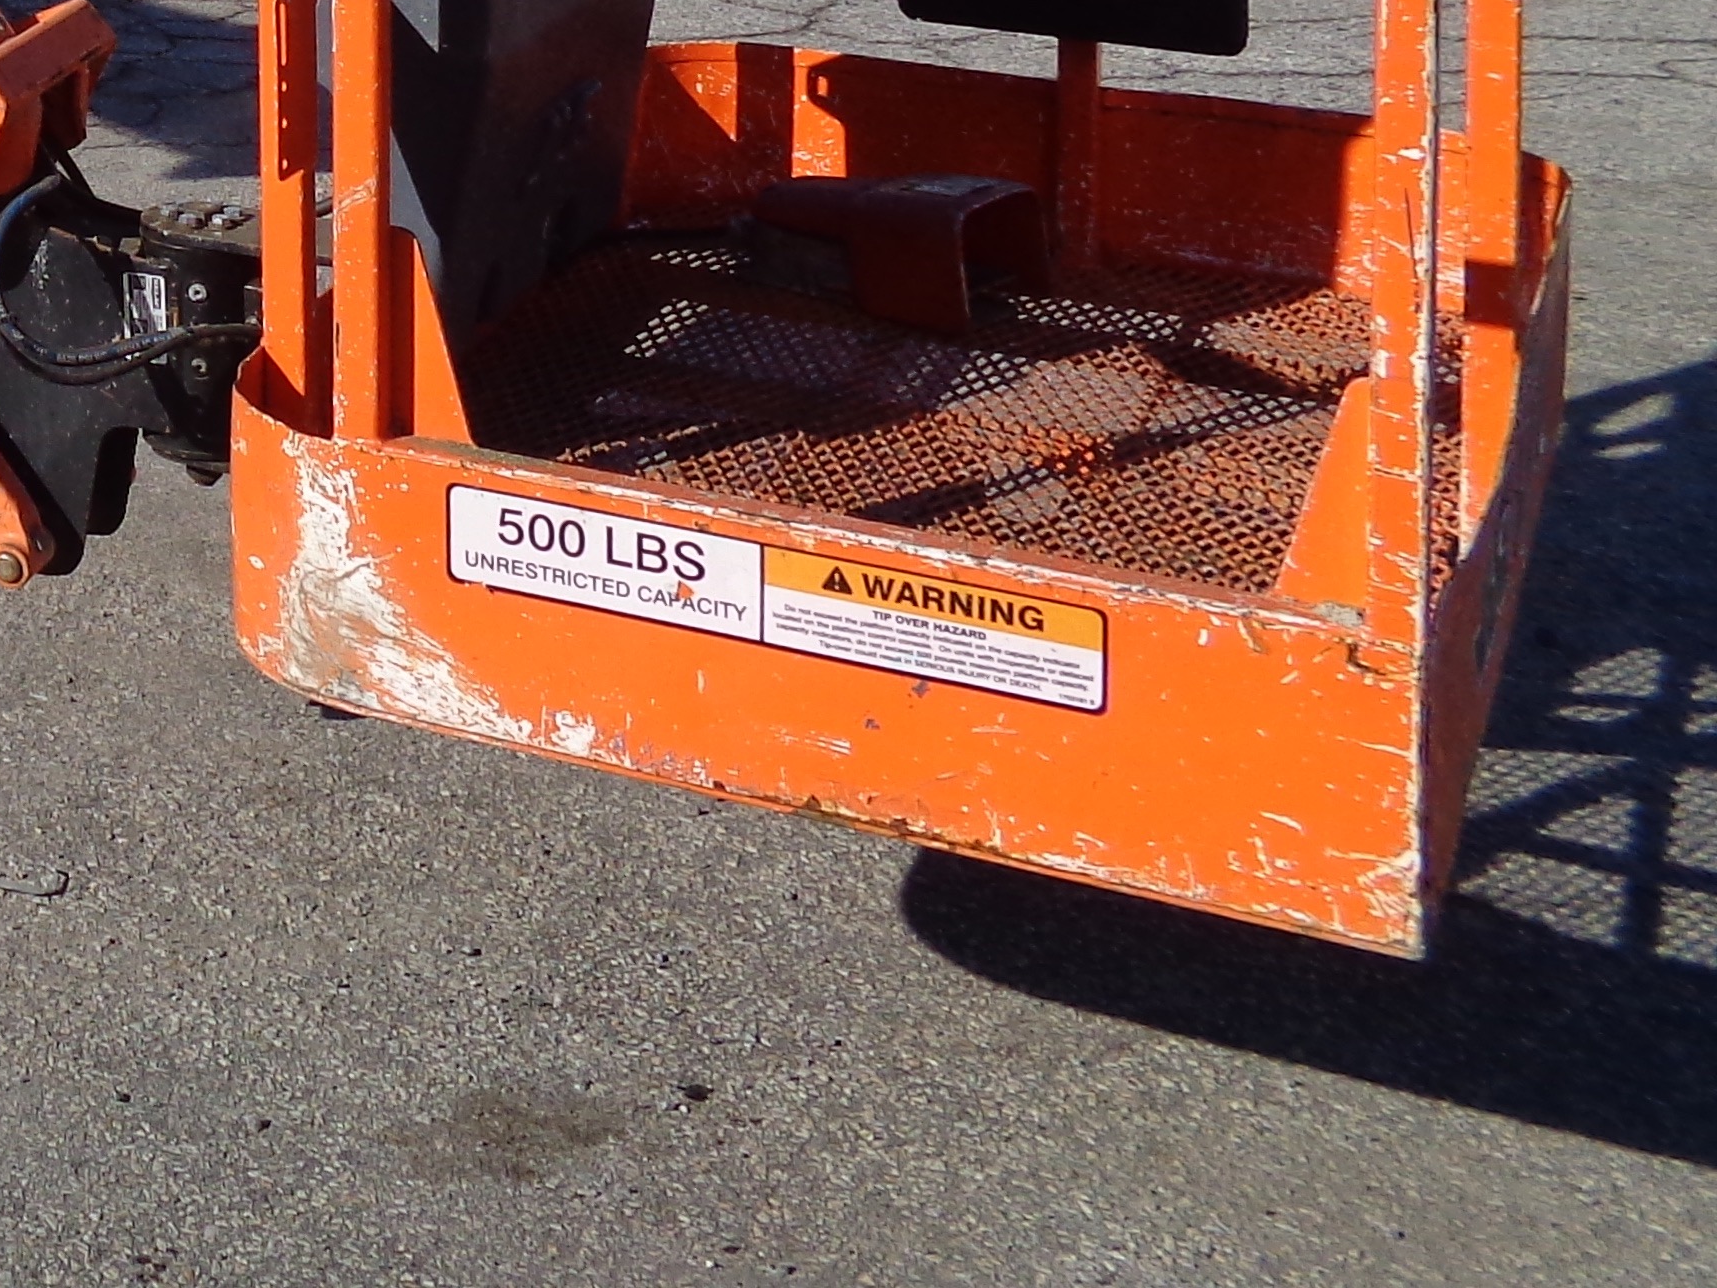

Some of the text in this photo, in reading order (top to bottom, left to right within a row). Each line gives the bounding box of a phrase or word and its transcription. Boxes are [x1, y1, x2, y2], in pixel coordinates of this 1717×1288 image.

[498, 508, 706, 582] 500 LBS
[465, 550, 630, 598] UNRESTRICTED
[861, 573, 1044, 632] WARNING
[872, 610, 986, 640] TIP OVER HAZARD
